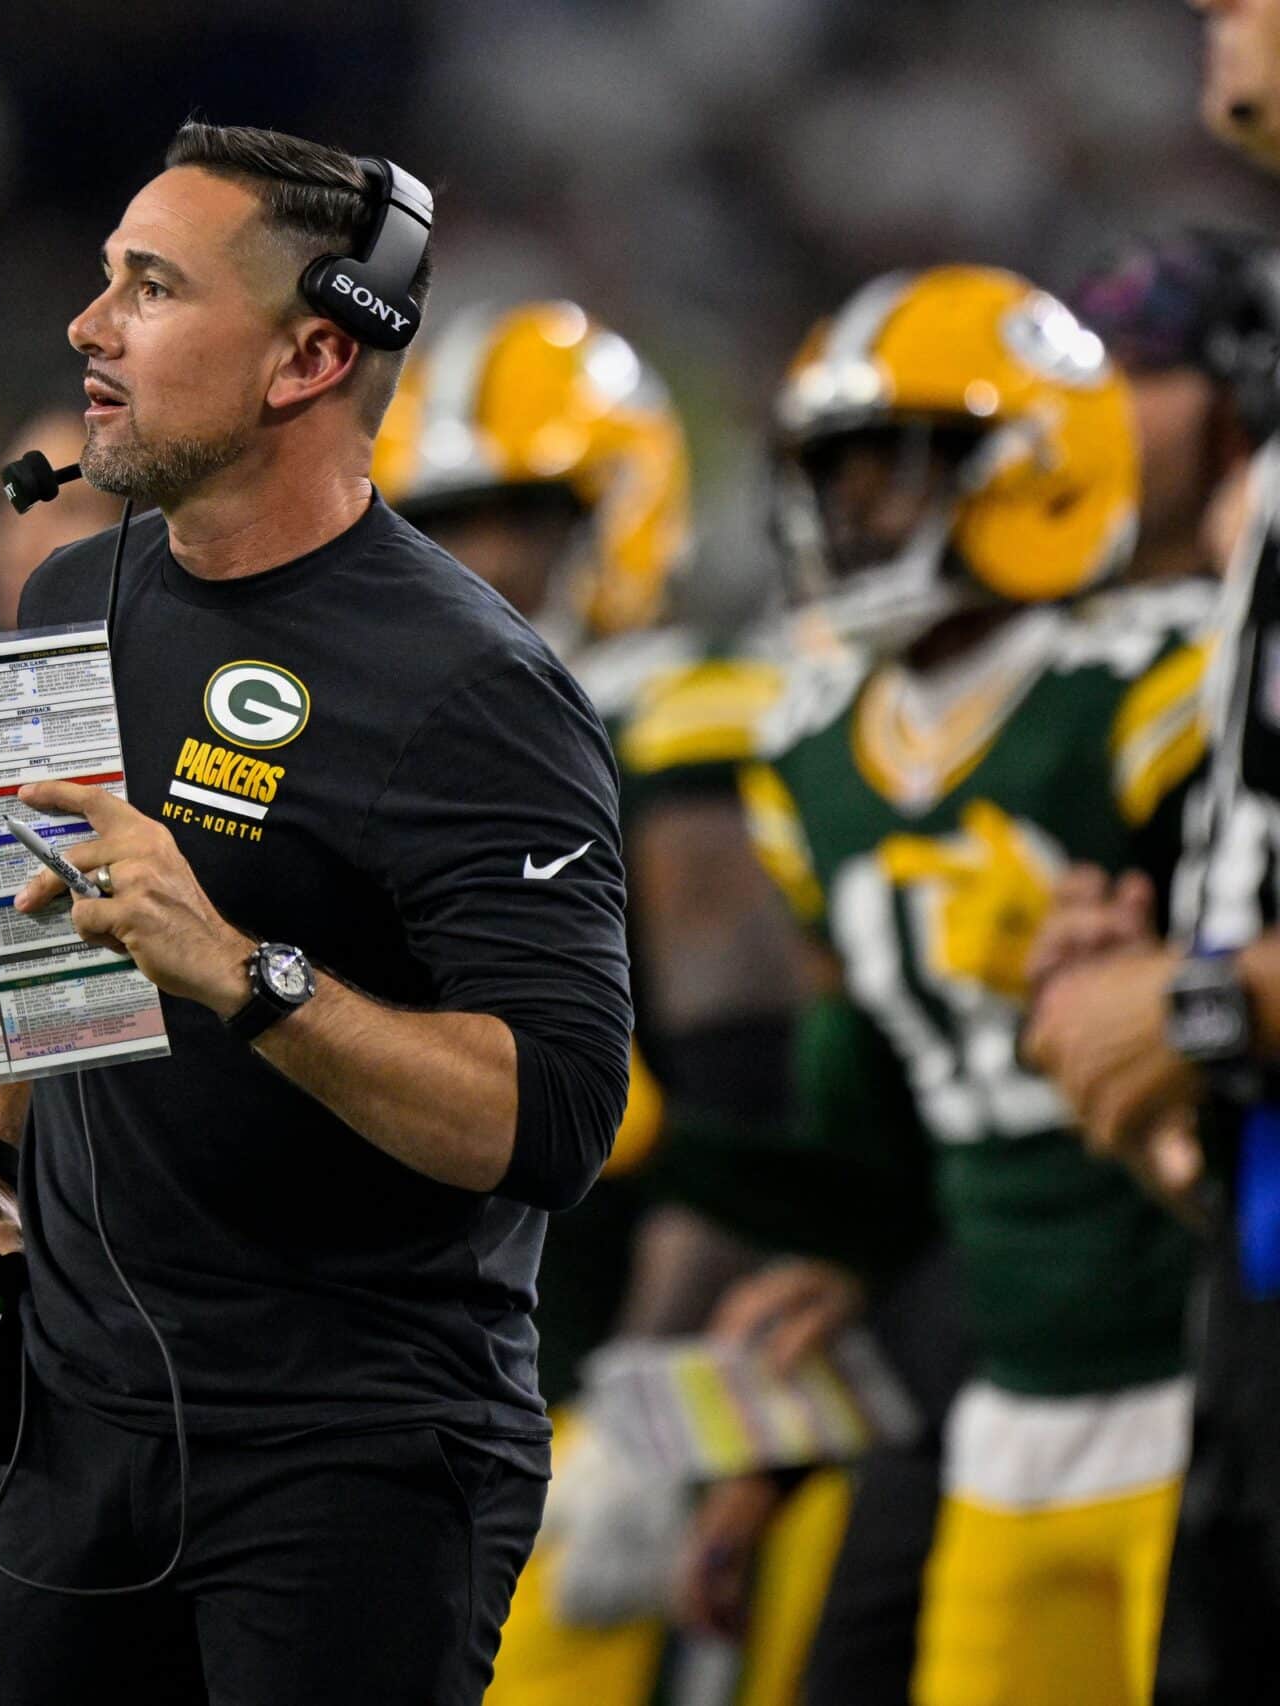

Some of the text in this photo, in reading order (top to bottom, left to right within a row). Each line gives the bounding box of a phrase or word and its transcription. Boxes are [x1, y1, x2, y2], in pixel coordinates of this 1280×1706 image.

[331, 274, 410, 331] SONY
[9, 662, 29, 670] QUICK
[17, 706, 52, 716] DROPBACK
[210, 667, 301, 741] G
[175, 737, 285, 803] PACKERS
[49, 827, 65, 836] PASS
[162, 801, 263, 842] NFC-NORTH
